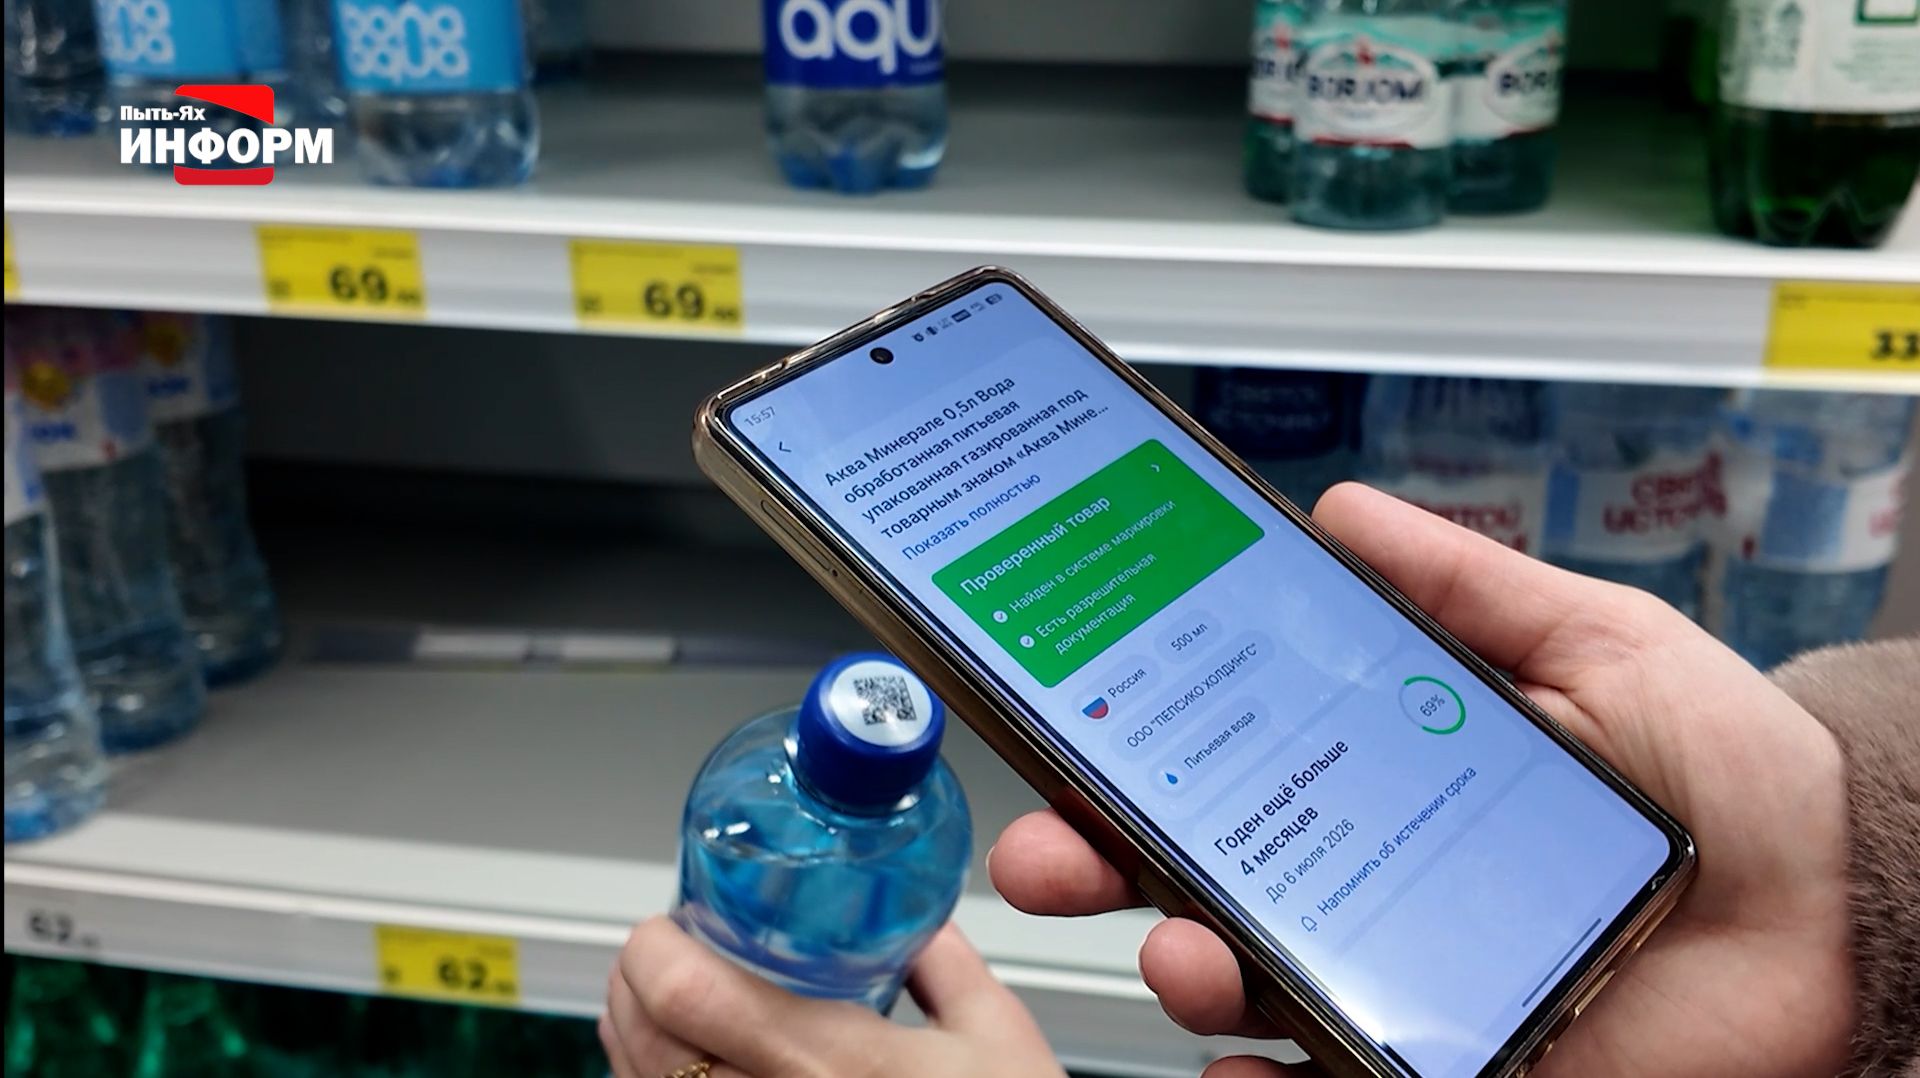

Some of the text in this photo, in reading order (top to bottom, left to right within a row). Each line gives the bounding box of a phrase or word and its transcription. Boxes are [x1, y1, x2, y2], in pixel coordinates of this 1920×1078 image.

[331, 264, 388, 304] 69
[644, 279, 705, 320] 69
[743, 406, 777, 428] 15:57
[824, 378, 1015, 486] Аква Минерале 0,5л Вода
[844, 400, 1020, 504] обработанная питьевая
[862, 389, 1089, 524] упакованная газированная под
[881, 488, 963, 539] товарным
[961, 456, 1017, 493] знаком
[1016, 429, 1060, 461] «Аква
[902, 474, 1041, 560] Показать полностью
[960, 496, 1111, 595] Проверенный товар
[1008, 500, 1177, 613] Найден в системе маркировки
[1035, 553, 1157, 638] Есть разрешительная
[1055, 593, 1137, 656] документация
[1171, 623, 1208, 651] 500 мл
[1107, 668, 1147, 698] Россия
[1127, 642, 1257, 748] ООО "ПЕПСИКО ХОЛДИНГС"
[1420, 694, 1446, 718] 69%
[1184, 711, 1256, 769] Питьевая вода
[1214, 740, 1349, 856] Годен ещё больше
[1317, 766, 1477, 916] Напомнить об истечении срока
[1240, 807, 1319, 877] 4 месяцев
[1265, 818, 1355, 904] До 6 июля 2026
